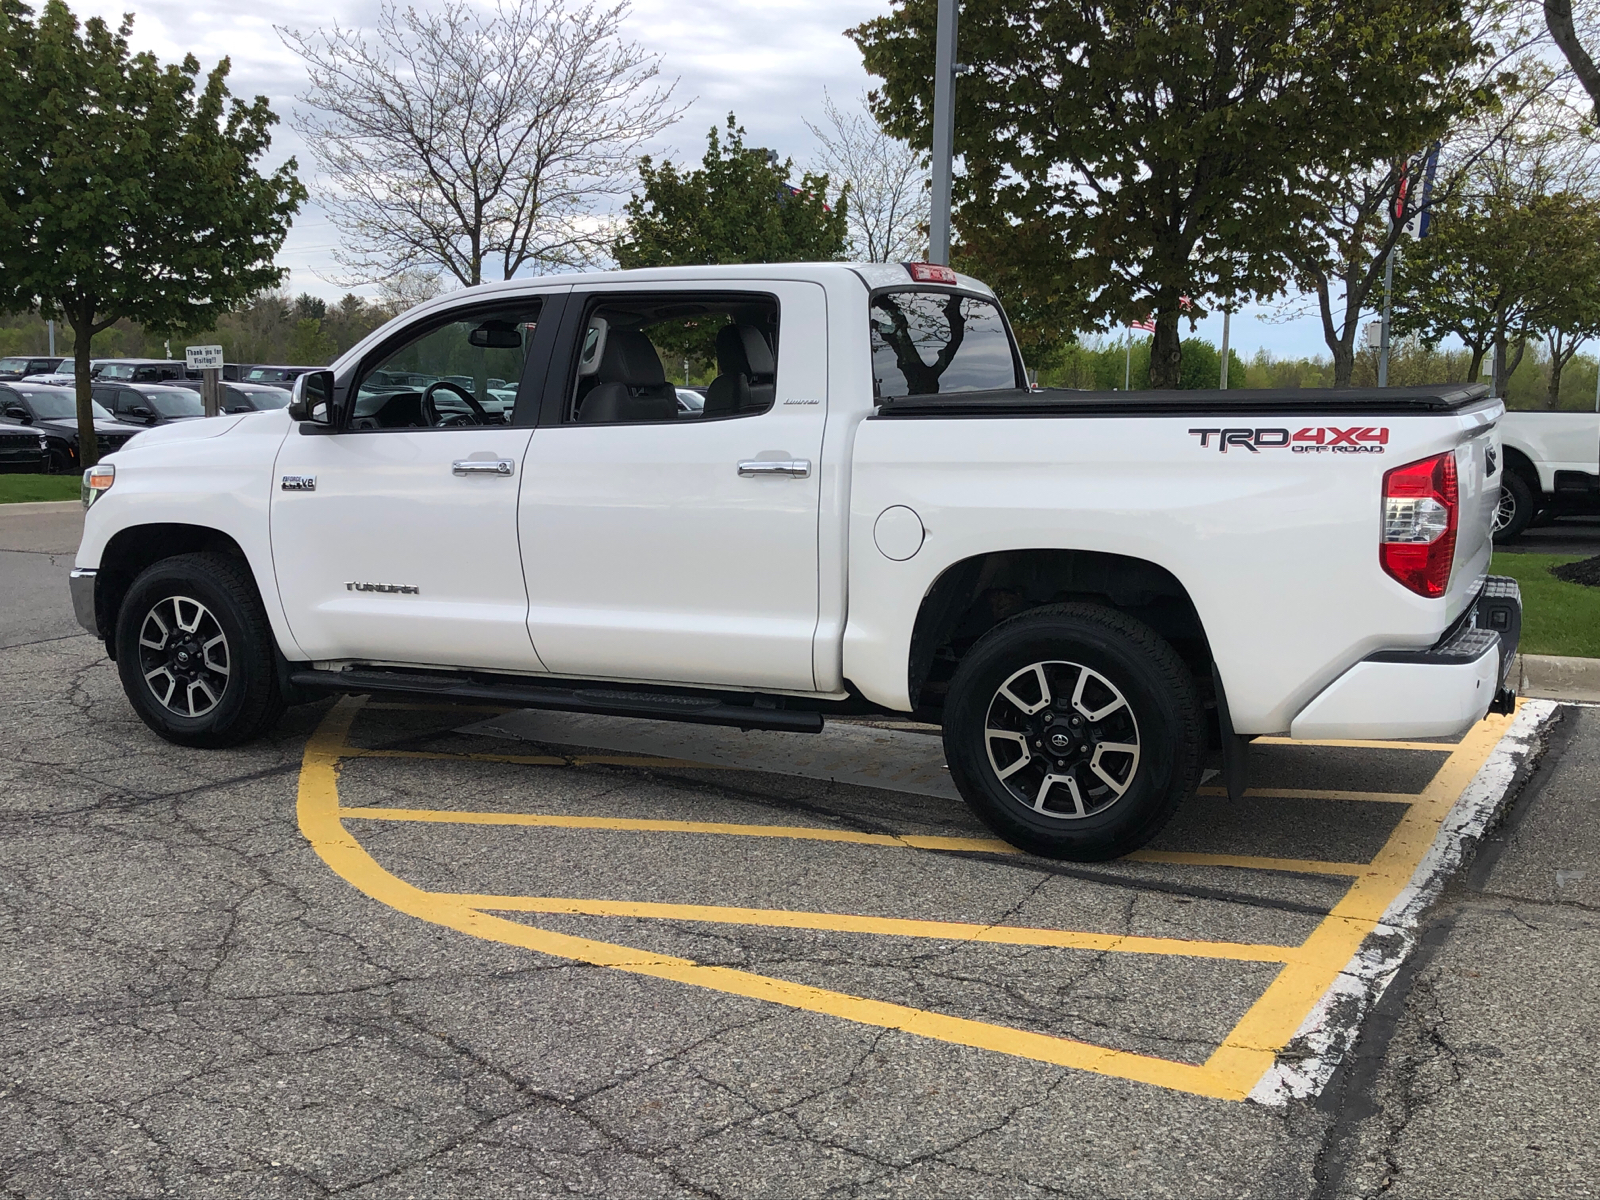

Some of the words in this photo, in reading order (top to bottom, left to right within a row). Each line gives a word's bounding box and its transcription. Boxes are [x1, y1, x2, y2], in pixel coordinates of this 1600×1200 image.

[1188, 428, 1291, 454] TRD
[1291, 445, 1330, 454] OFF
[1331, 445, 1386, 454] ROAD
[301, 478, 314, 487] V8
[343, 581, 420, 595] TUNDRA
